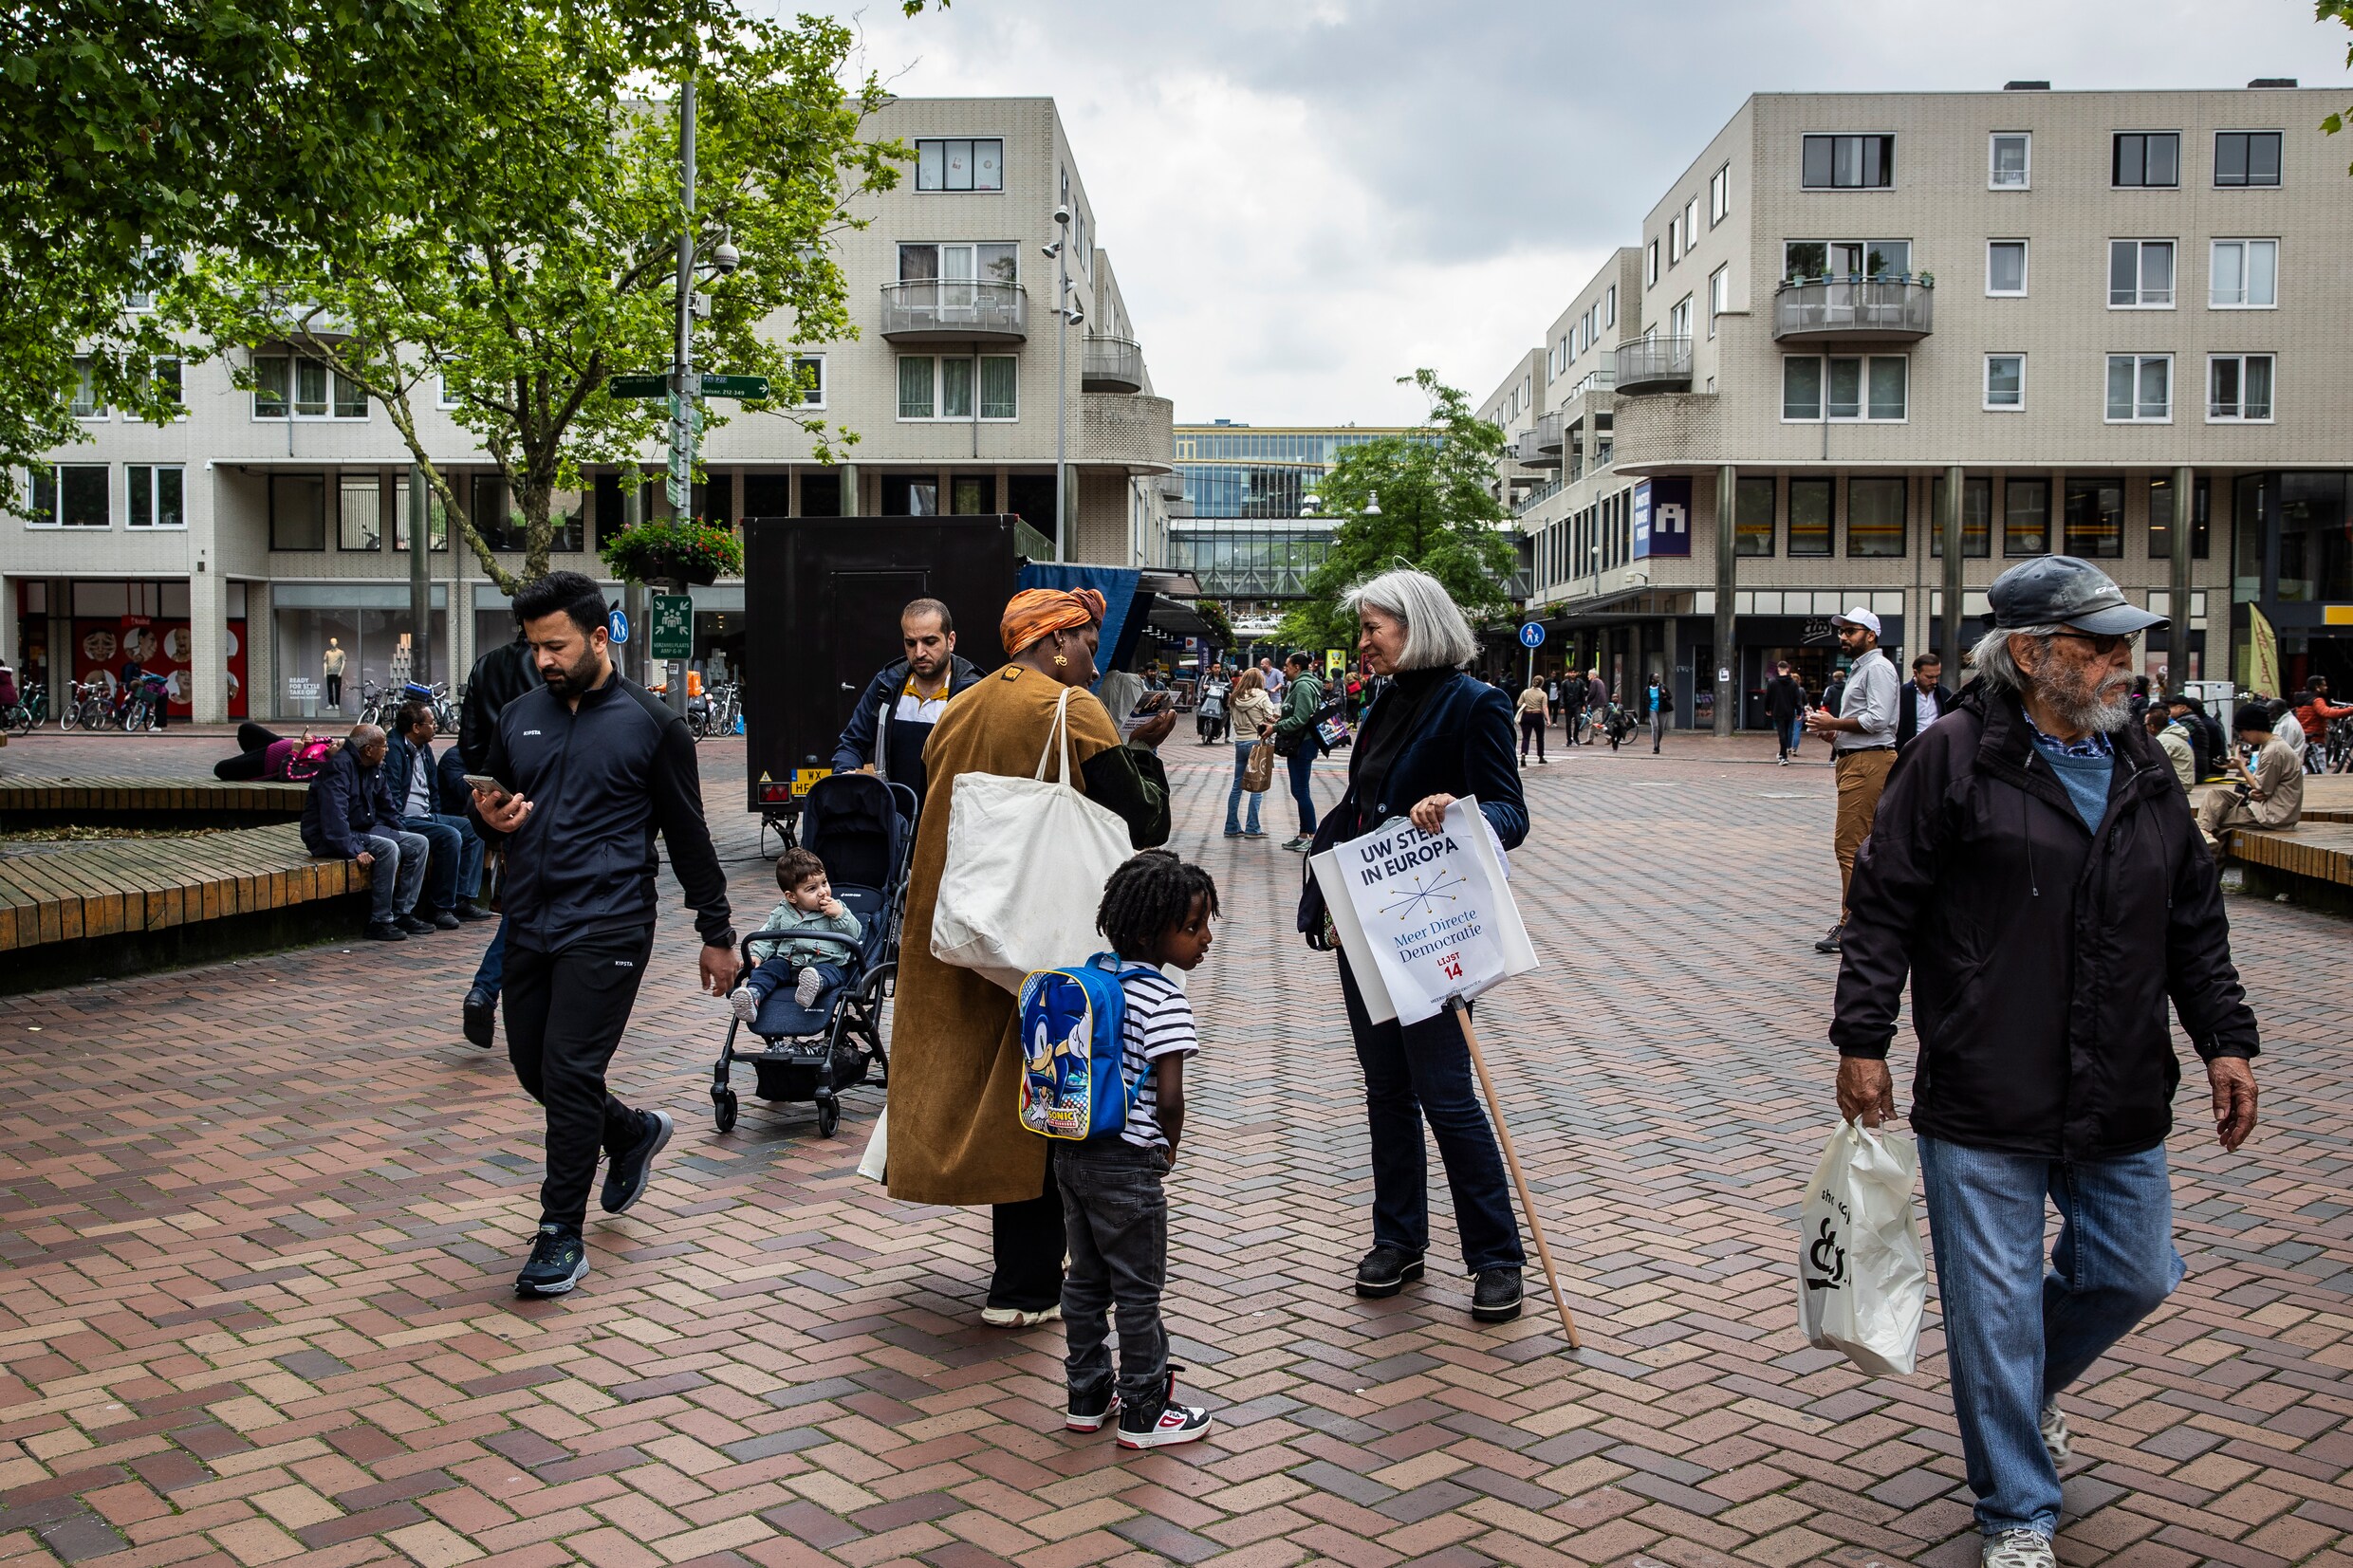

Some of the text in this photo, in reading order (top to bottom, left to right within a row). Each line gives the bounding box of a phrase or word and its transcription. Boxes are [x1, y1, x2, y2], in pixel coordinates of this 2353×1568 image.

[807, 770, 822, 781] WX
[1360, 838, 1392, 863] UW
[1361, 837, 1459, 886] IN EUROPA
[1394, 910, 1477, 949] Meer Directe
[1399, 924, 1482, 963] Democratie
[1436, 951, 1460, 967] LIJST
[1444, 962, 1463, 981] 14
[1048, 1110, 1074, 1121] SONIC
